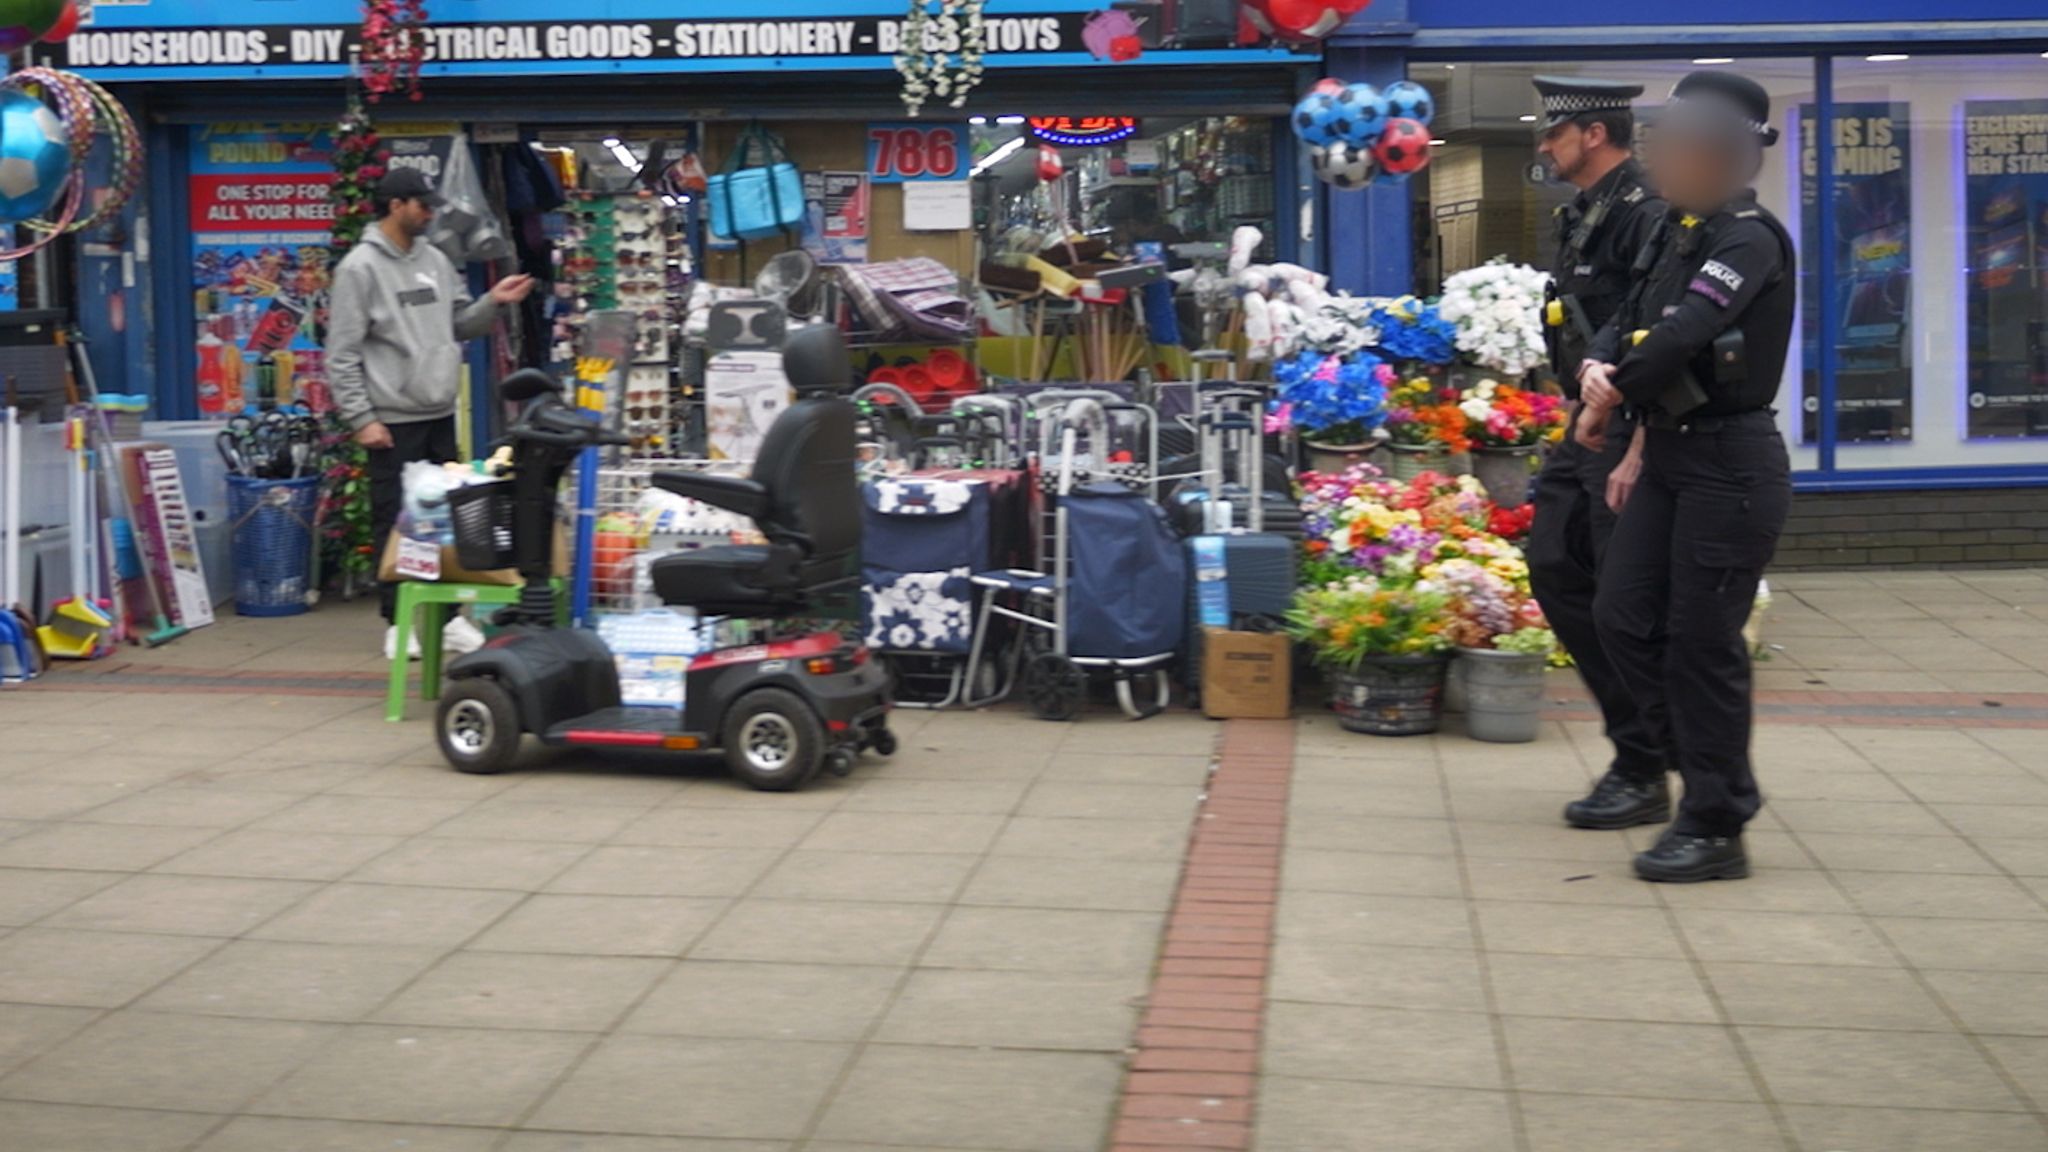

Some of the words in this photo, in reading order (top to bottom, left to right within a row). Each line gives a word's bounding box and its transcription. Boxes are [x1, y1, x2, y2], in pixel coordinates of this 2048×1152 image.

[67, 31, 268, 65] HOUSEHOLDS
[291, 29, 344, 62] DIY
[546, 24, 653, 58] GOODS
[674, 22, 854, 57] STATIONERY
[983, 18, 1061, 51] TOYS
[1803, 118, 1862, 147] TIS
[1867, 117, 1893, 146] IS
[869, 127, 958, 177] 786
[1967, 136, 2019, 155] SPINS
[1967, 155, 2002, 175] NEW
[217, 185, 250, 200] ONE
[252, 184, 295, 200] STOP
[297, 184, 330, 199] FOR
[208, 205, 240, 220] ALL
[244, 204, 292, 219] YOUR
